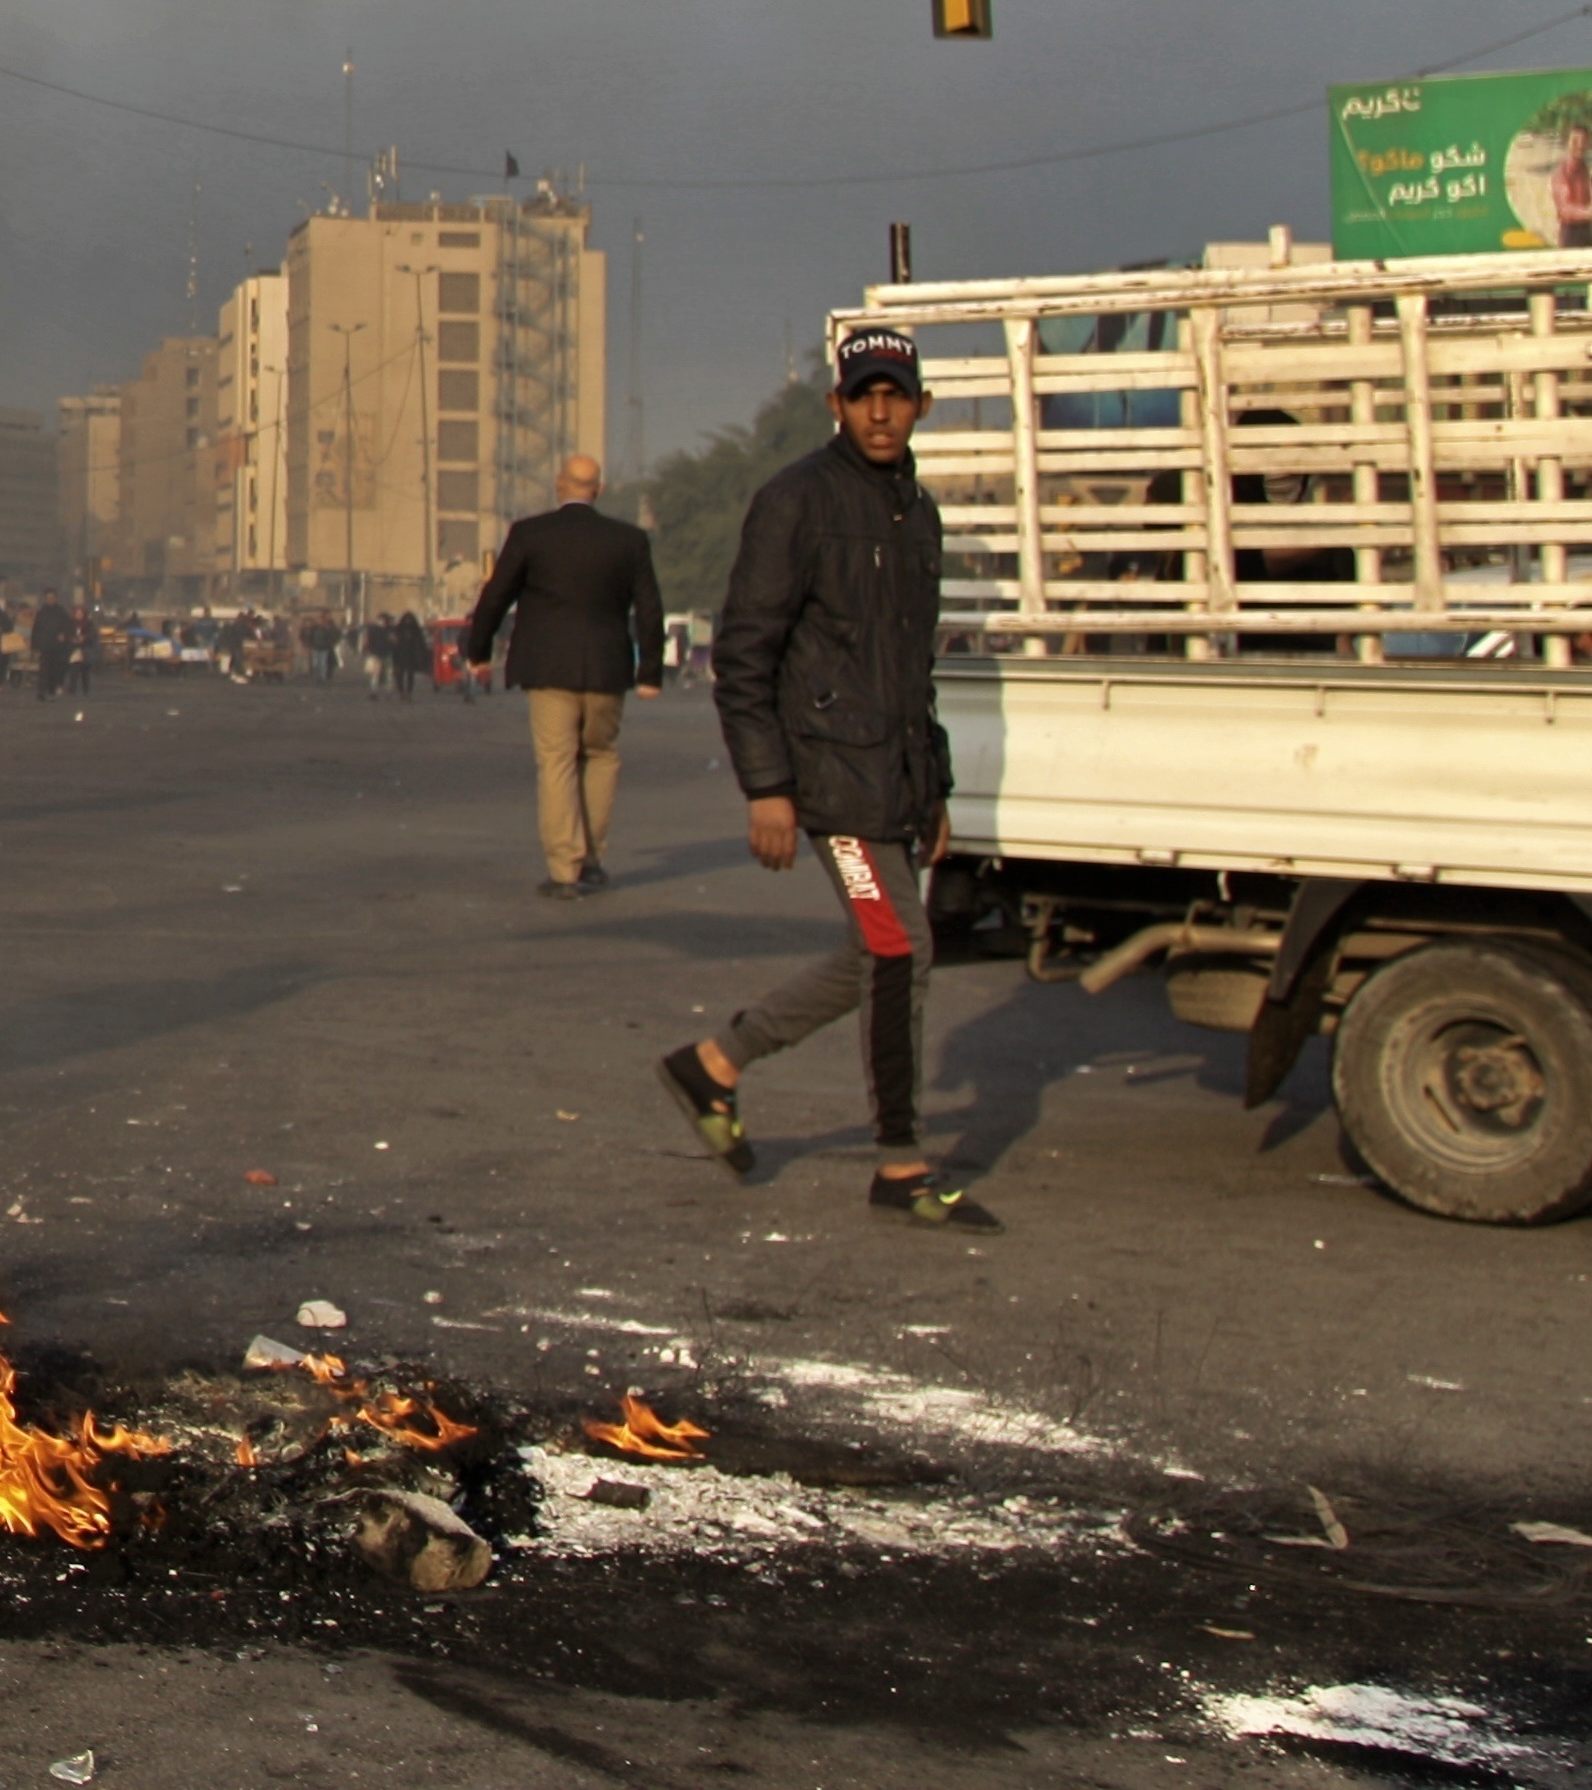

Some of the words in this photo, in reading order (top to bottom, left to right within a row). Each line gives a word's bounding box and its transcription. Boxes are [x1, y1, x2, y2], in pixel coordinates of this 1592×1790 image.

[1342, 88, 1401, 120] كريم
[1430, 141, 1486, 174] شكو
[1388, 175, 1440, 207] كريم
[841, 334, 913, 359] TOMMY
[829, 835, 881, 901] COMBAT
